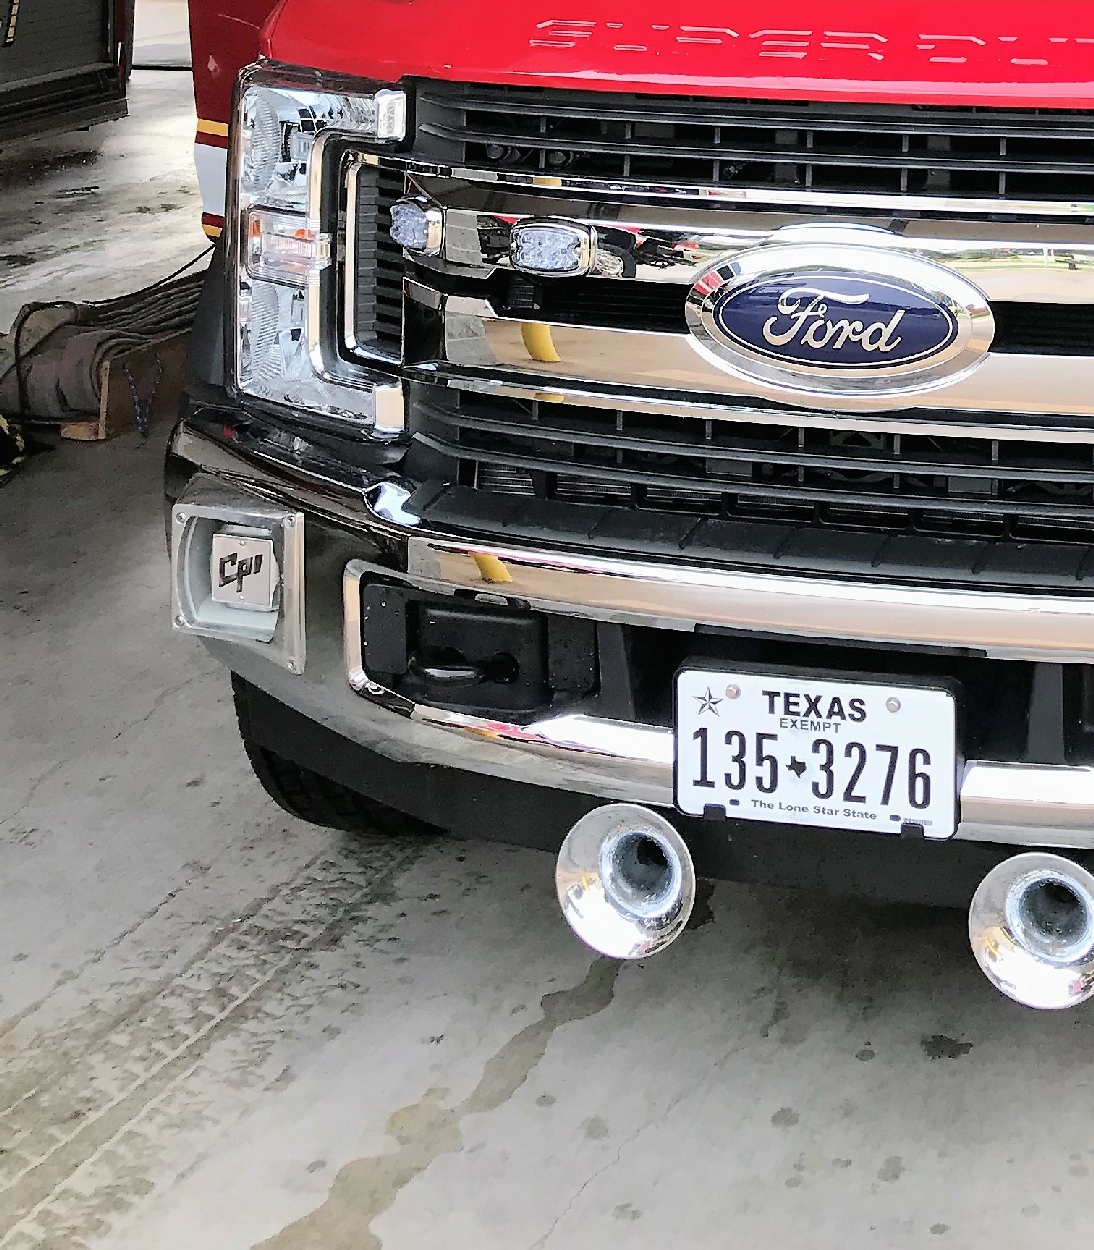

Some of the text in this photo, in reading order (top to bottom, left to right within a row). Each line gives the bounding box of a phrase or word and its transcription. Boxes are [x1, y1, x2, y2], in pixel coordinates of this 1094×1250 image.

[528, 19, 889, 62] SUPER
[762, 287, 906, 352] Ford
[762, 690, 867, 723] TEXAS
[779, 717, 841, 734] EXEMPT
[751, 799, 877, 820] The Lone Star State
